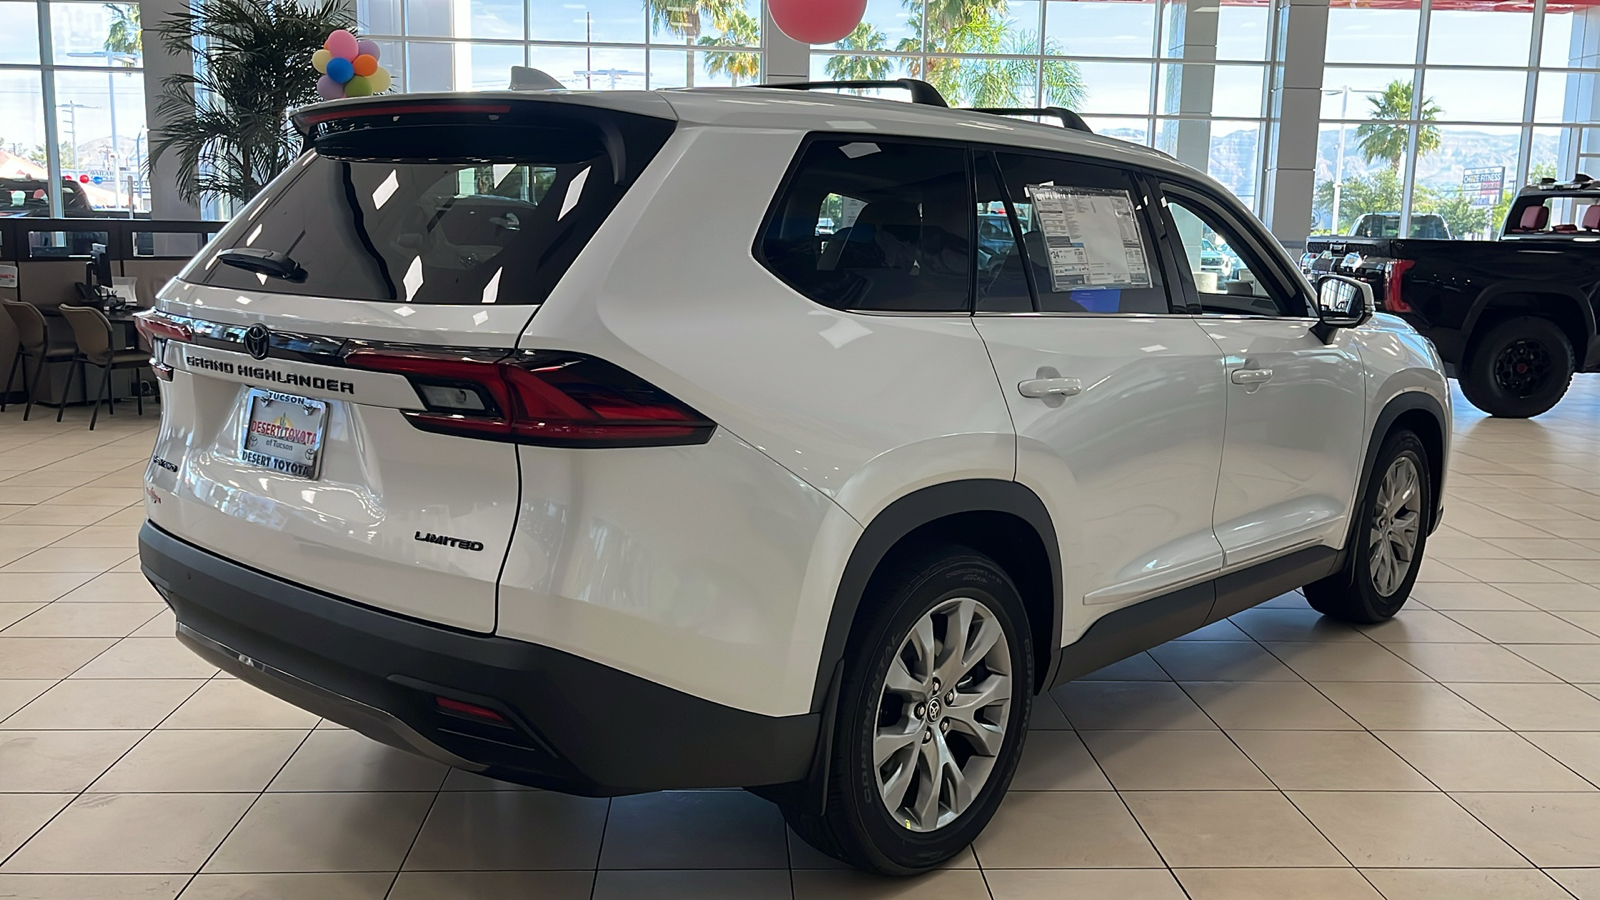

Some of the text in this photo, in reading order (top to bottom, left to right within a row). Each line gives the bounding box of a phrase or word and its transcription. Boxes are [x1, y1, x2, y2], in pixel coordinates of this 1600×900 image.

[186, 356, 355, 394] GRAND HIGHLANDER
[268, 391, 305, 405] TUCSON
[251, 420, 317, 445] DESERT TOYOTA
[265, 439, 293, 451] of Tucson
[242, 451, 309, 476] DESERT TOYOTA
[414, 531, 484, 551] LIMITED
